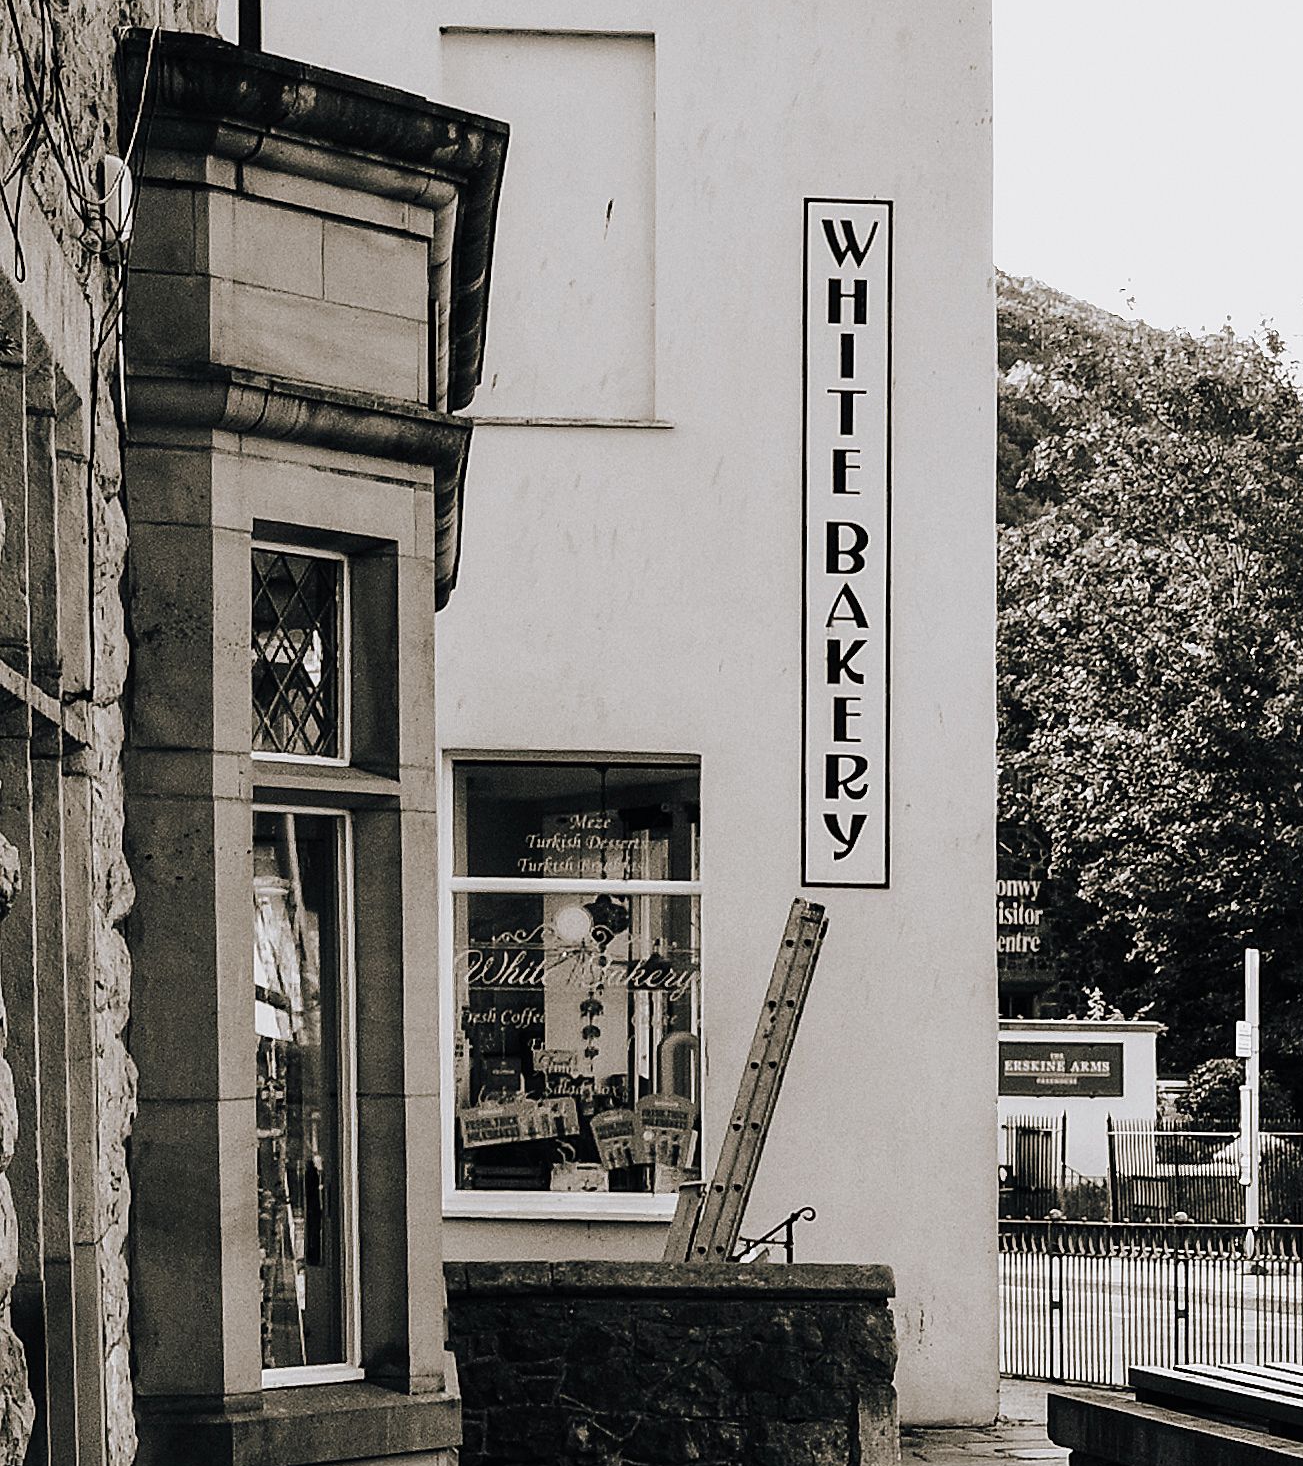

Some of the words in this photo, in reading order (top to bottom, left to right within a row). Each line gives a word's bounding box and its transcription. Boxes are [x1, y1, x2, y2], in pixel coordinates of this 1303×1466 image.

[821, 219, 879, 495] WHITE
[822, 521, 870, 861] BAKERY
[525, 833, 581, 853] Turkish
[517, 856, 574, 874] Turkish
[997, 879, 1042, 902] onwy
[998, 900, 1044, 925] isitor
[997, 931, 1041, 953] entre
[1004, 1060, 1065, 1072] ERSKINE
[1070, 1061, 1110, 1073] ARMS
